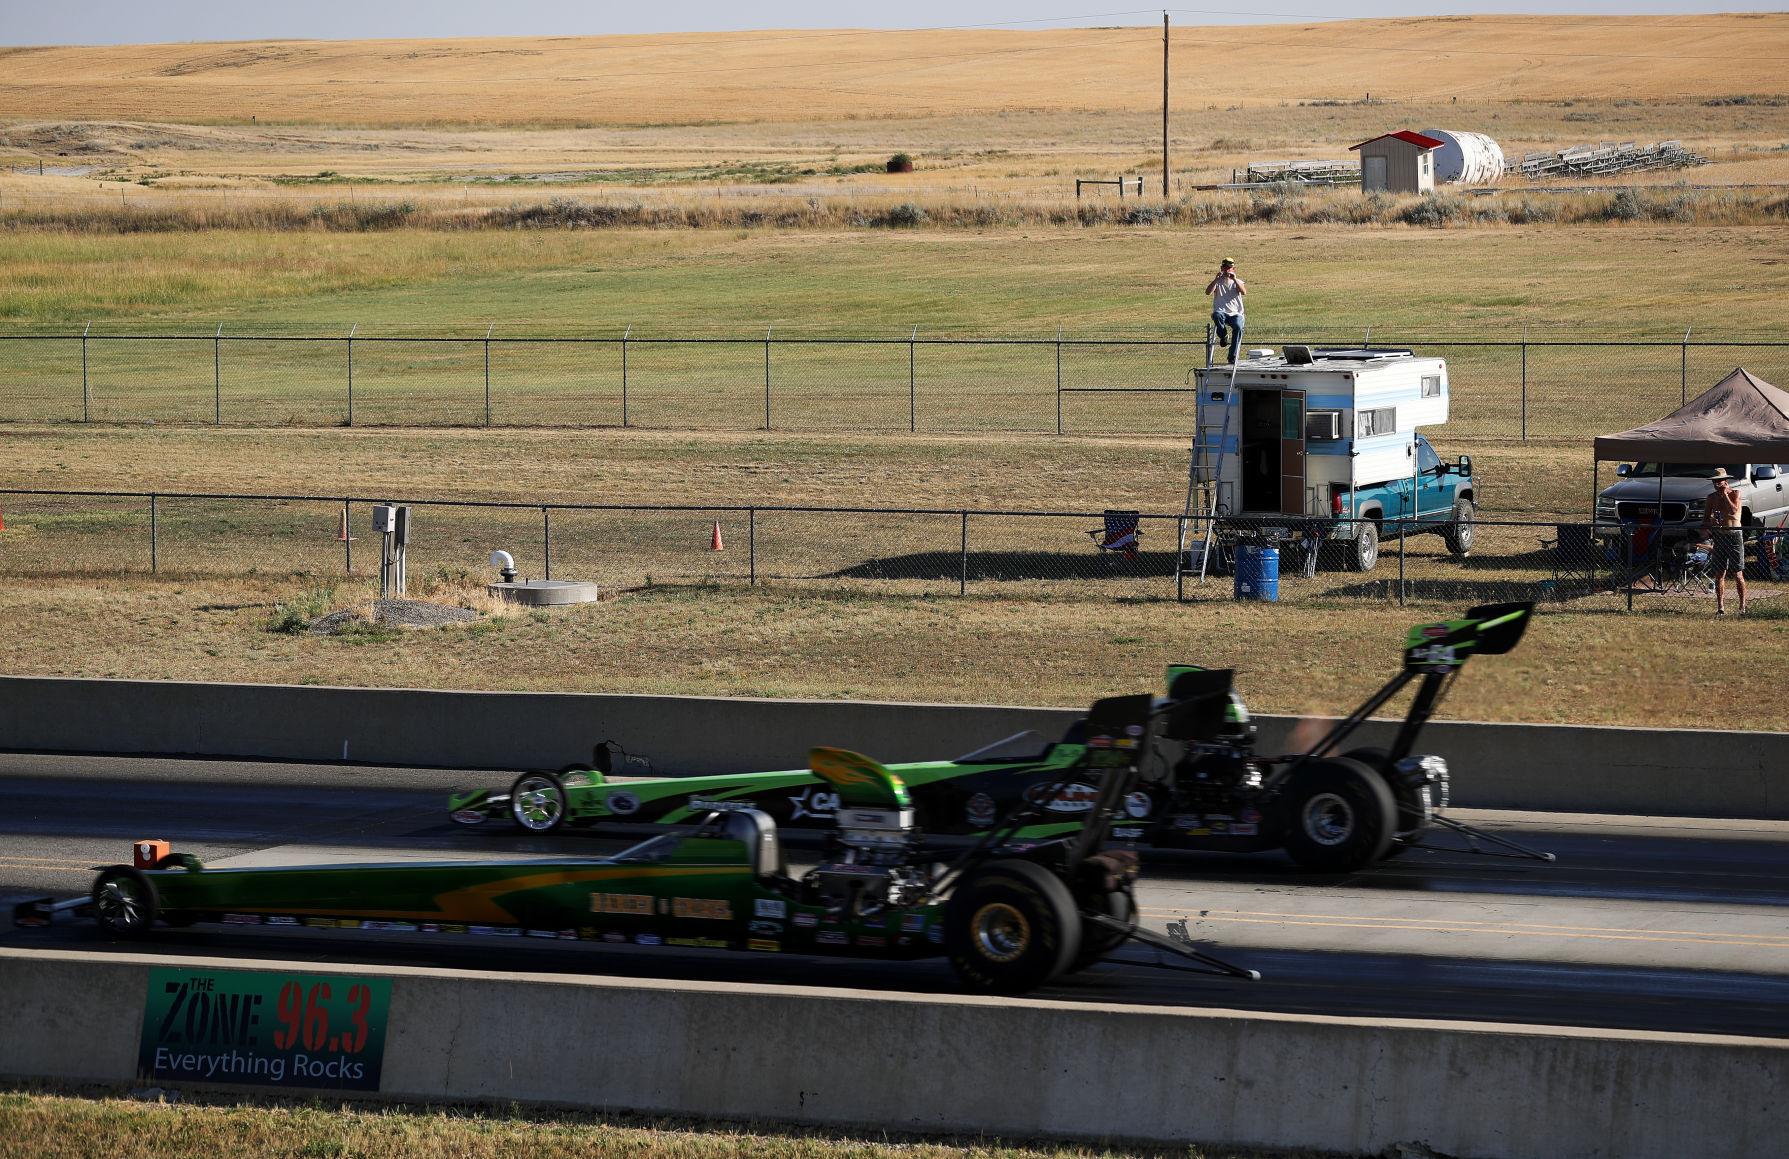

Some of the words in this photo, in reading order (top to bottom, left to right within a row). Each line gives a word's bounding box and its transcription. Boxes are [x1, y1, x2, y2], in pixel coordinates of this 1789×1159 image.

[190, 977, 215, 992] THE
[158, 982, 263, 1047] ZONE
[273, 981, 371, 1053] 96.3
[154, 1048, 285, 1081] Everything
[293, 1054, 364, 1080] Rocks
